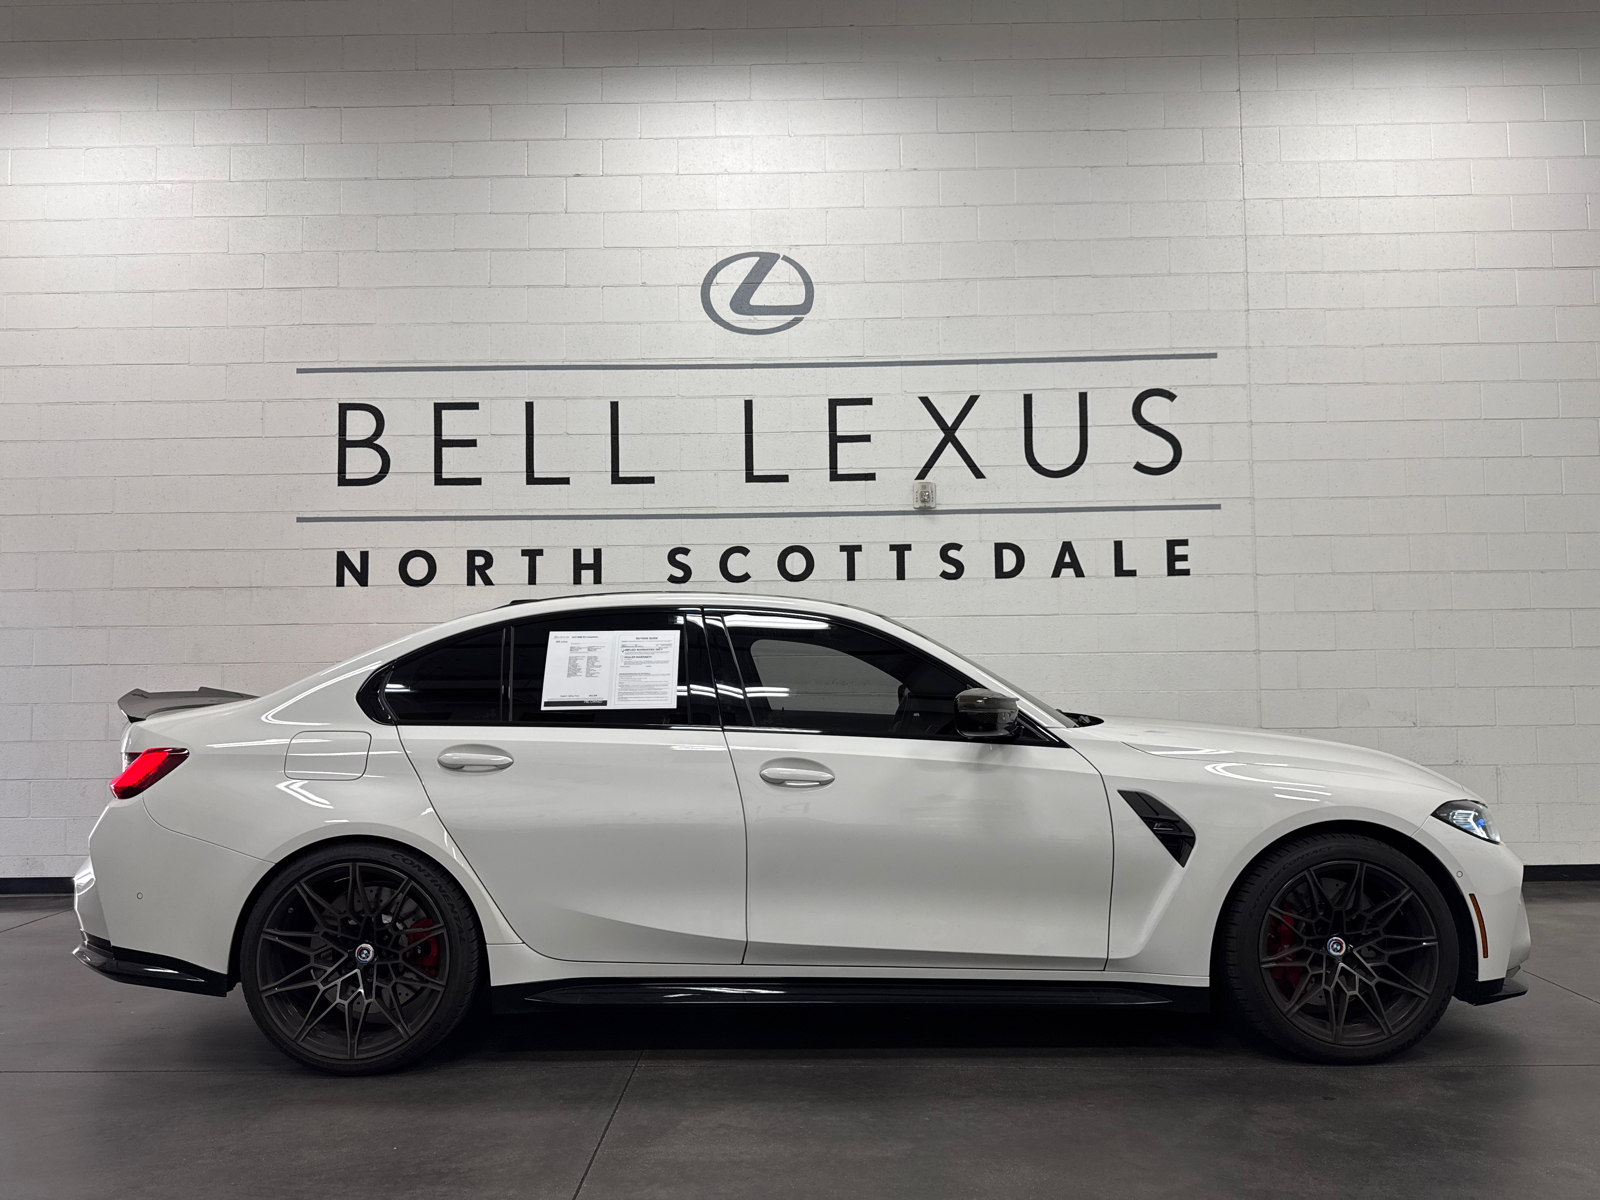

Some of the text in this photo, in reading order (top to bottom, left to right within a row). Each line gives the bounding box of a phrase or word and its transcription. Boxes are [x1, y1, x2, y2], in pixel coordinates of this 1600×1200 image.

[337, 387, 1183, 487] BELL LEXUS
[335, 538, 1191, 588] NORTH SCOTTSDALE
[390, 853, 467, 944] CONTINENTAL
